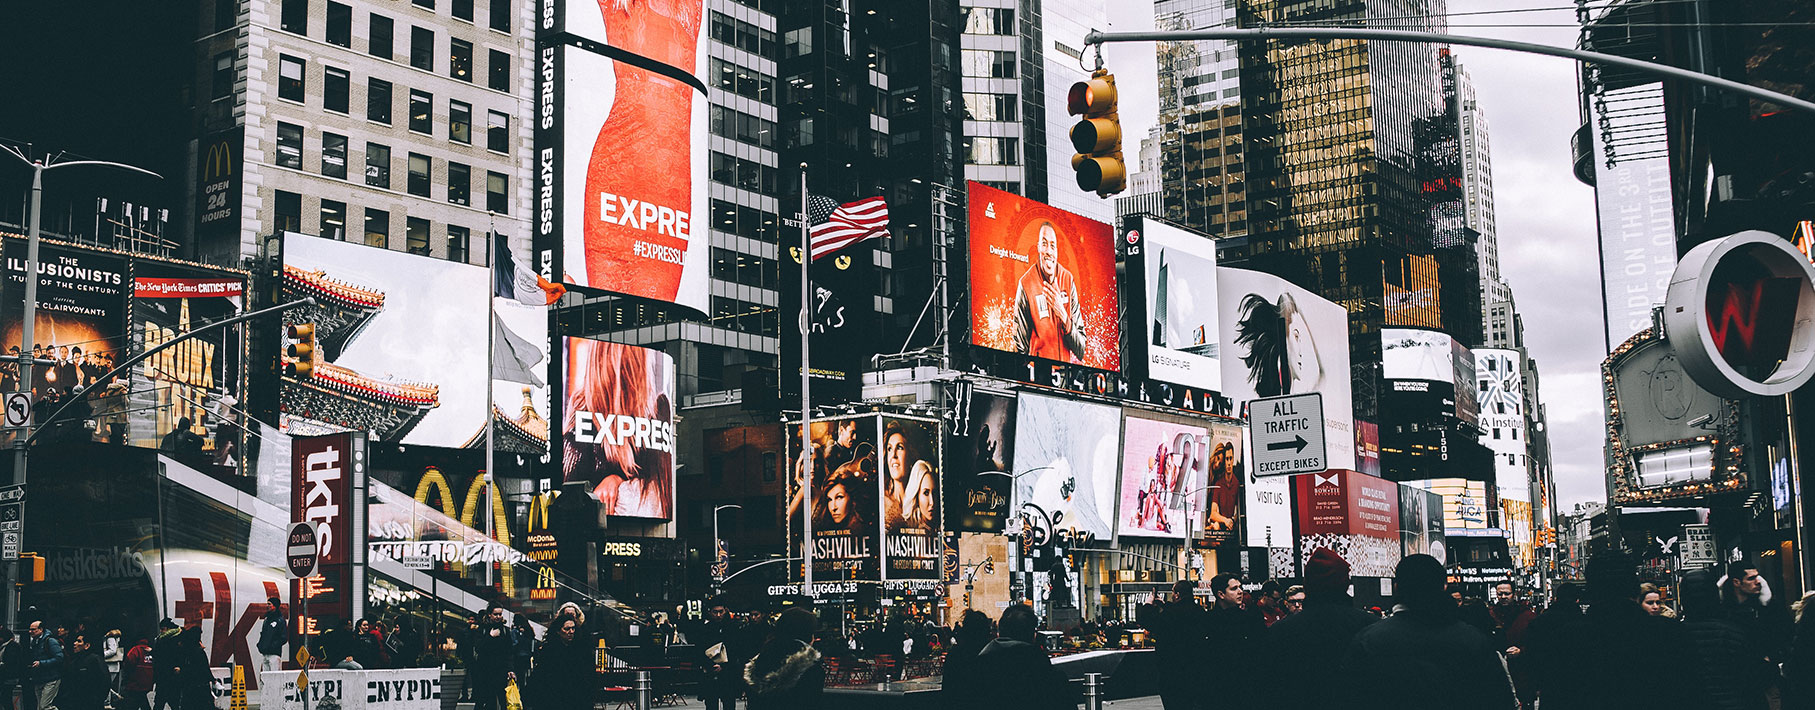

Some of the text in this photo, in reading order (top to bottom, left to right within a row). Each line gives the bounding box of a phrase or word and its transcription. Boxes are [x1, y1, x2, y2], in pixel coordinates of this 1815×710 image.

[542, 47, 554, 130] EXPRESS
[205, 180, 230, 193] OPEN
[541, 148, 553, 235] EXPRESS
[207, 192, 227, 211] 24
[201, 207, 231, 223] HOURS
[1620, 202, 1644, 241] THE
[990, 244, 1029, 264] Dwight Howard
[1127, 245, 1139, 256] LG
[59, 256, 78, 267] THE
[1623, 248, 1646, 275] ON
[56, 281, 73, 290] THE
[77, 284, 117, 295] CENTURY
[147, 281, 161, 292] New
[161, 282, 178, 294] York
[177, 282, 198, 293] Times
[226, 281, 242, 292] PICK
[22, 299, 106, 317] TE CLAIRVOYANTS
[143, 320, 215, 389] BRONX
[1151, 354, 1191, 371] LG SIGNATURE
[1272, 400, 1298, 417] ALL
[1264, 418, 1309, 434] TRAFFIC
[1259, 457, 1319, 472] EXCEPT BIKES
[305, 445, 341, 557] tkts
[1255, 490, 1284, 505] VISIT US
[292, 533, 312, 544] DO NOT
[886, 535, 939, 558] NASHVILLE
[292, 558, 311, 568] ENTER
[767, 585, 799, 596] GIFTS
[884, 580, 904, 590] GIFTS
[378, 679, 432, 701] NYPD
